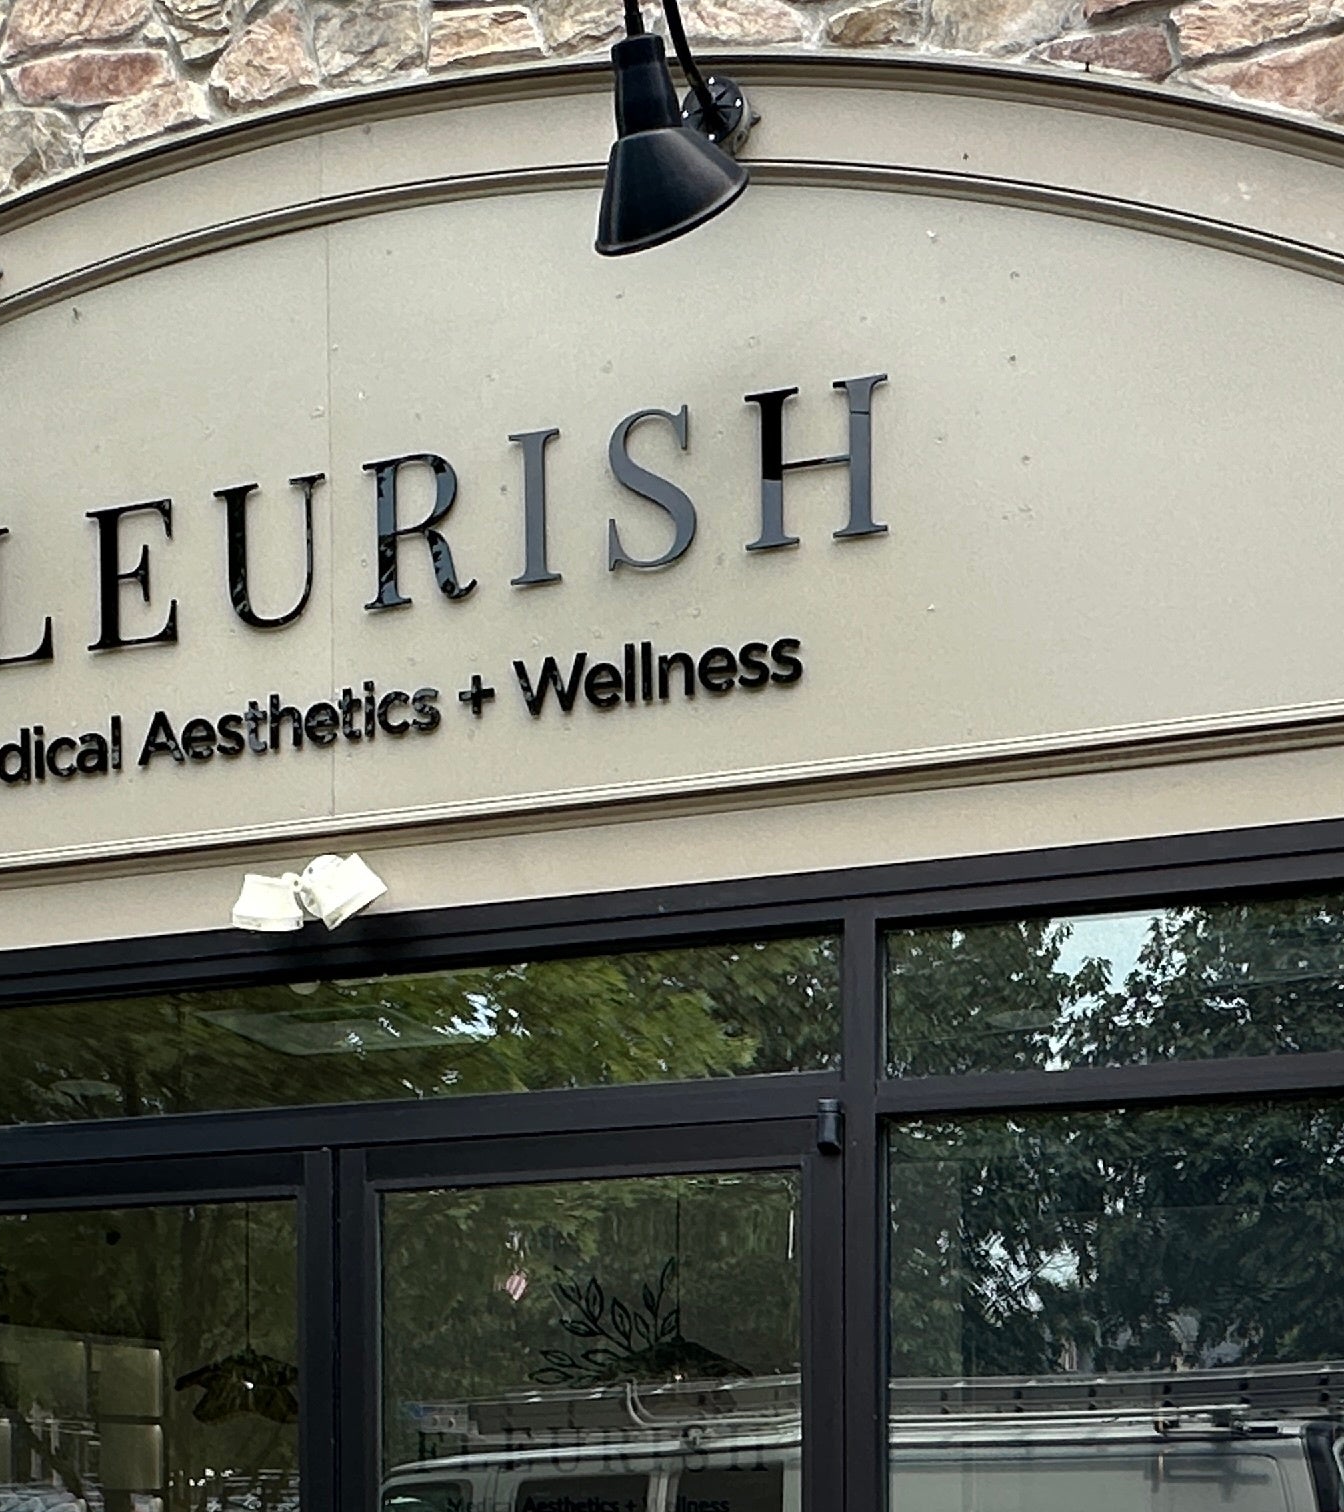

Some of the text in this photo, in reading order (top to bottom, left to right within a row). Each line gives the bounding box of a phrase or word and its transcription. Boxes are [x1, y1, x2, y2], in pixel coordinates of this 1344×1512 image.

[138, 679, 442, 768] Aesthetics
[458, 673, 496, 717] +
[513, 636, 803, 718] Wellness
[417, 1425, 770, 1474] FLEURISH
